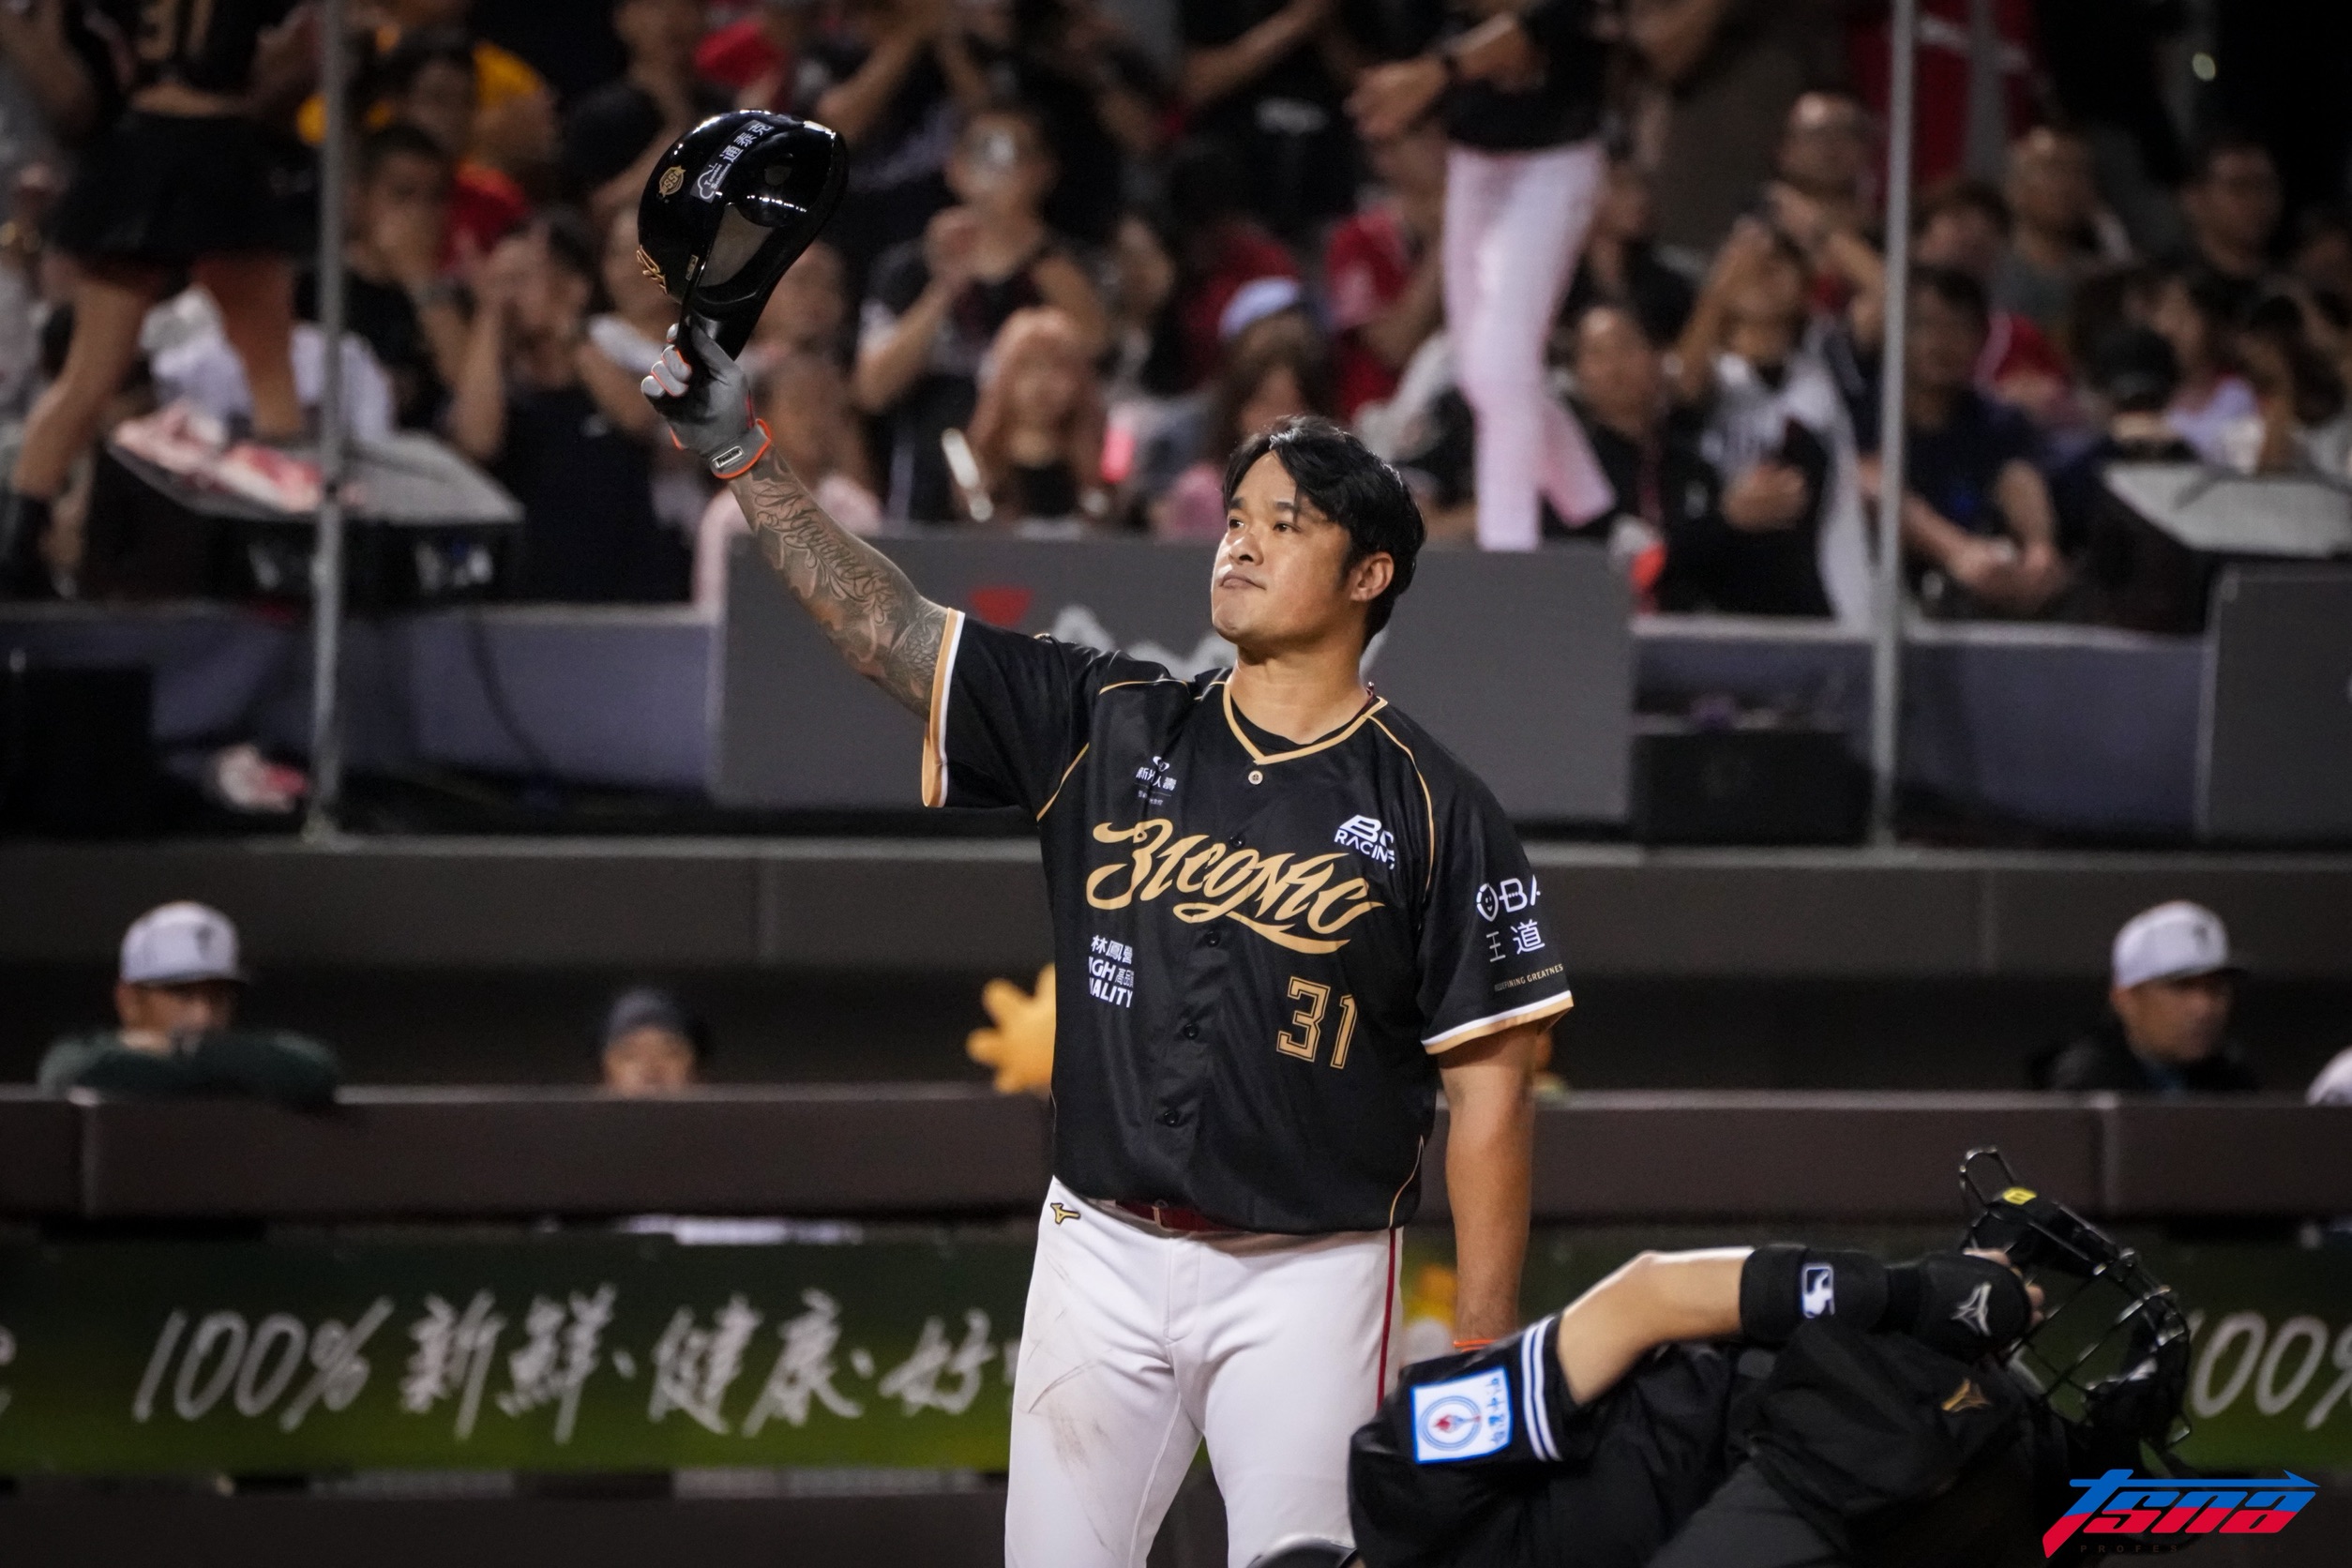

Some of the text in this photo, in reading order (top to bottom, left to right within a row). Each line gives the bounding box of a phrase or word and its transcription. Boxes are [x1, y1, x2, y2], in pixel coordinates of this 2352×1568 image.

[719, 123, 775, 163] 通泰克
[1485, 919, 1545, 963] 王道
[1089, 956, 1116, 982] IGH
[1526, 963, 1564, 984] GREATNES
[1276, 975, 1358, 1069] 31
